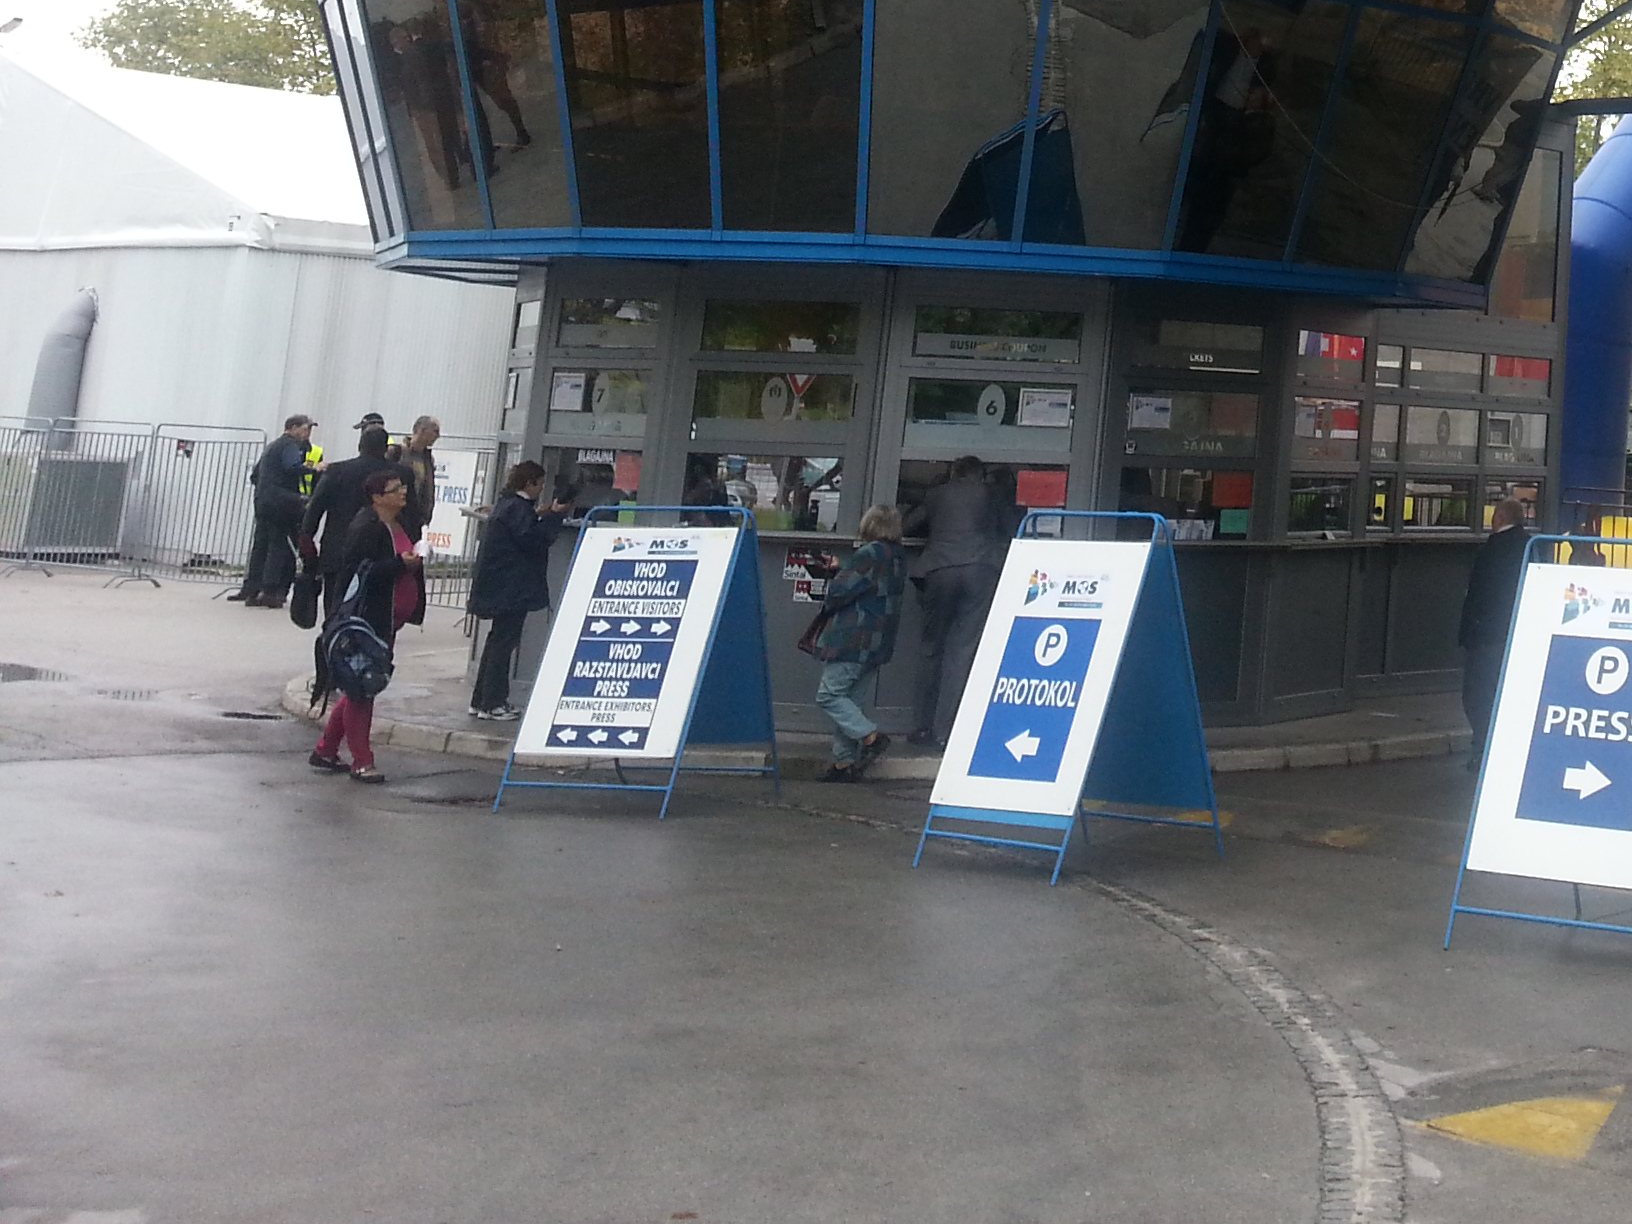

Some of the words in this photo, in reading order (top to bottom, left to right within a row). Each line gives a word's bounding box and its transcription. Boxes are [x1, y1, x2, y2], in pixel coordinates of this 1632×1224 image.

[985, 400, 998, 416] 6
[443, 486, 468, 504] PRESS
[634, 562, 667, 578] VHOD
[604, 580, 680, 597] OBISKOVALCI
[1062, 580, 1099, 595] MOS
[591, 600, 640, 615] ENTRANCE
[639, 601, 682, 616] VISITORS
[608, 643, 642, 659] VHOD
[1042, 632, 1061, 658] P
[573, 661, 662, 679] RAZSTAVLJAVCI
[1596, 655, 1619, 685] P
[593, 680, 630, 697] PRESS
[993, 677, 1077, 708] PROTOKOL
[559, 700, 602, 711] ENTRANCE
[590, 712, 616, 723] PRESS
